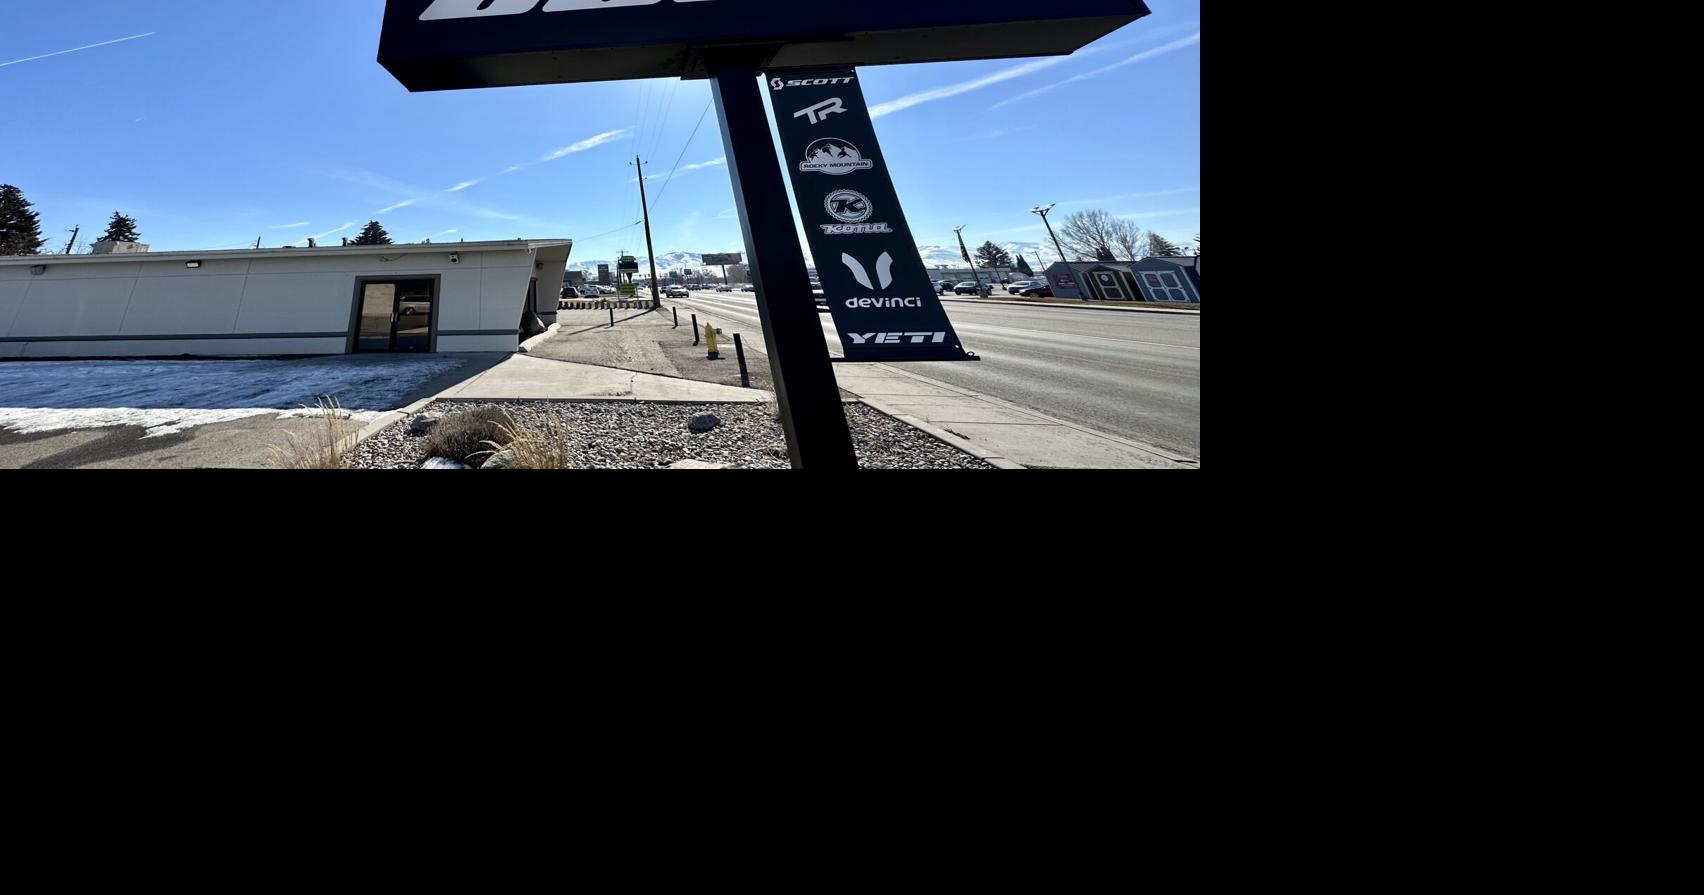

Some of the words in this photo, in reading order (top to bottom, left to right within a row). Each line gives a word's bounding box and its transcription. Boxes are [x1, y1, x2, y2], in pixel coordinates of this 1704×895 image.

[785, 76, 854, 87] SCOTT
[793, 97, 848, 125] TR
[830, 197, 866, 214] K
[847, 331, 946, 344] YETI
